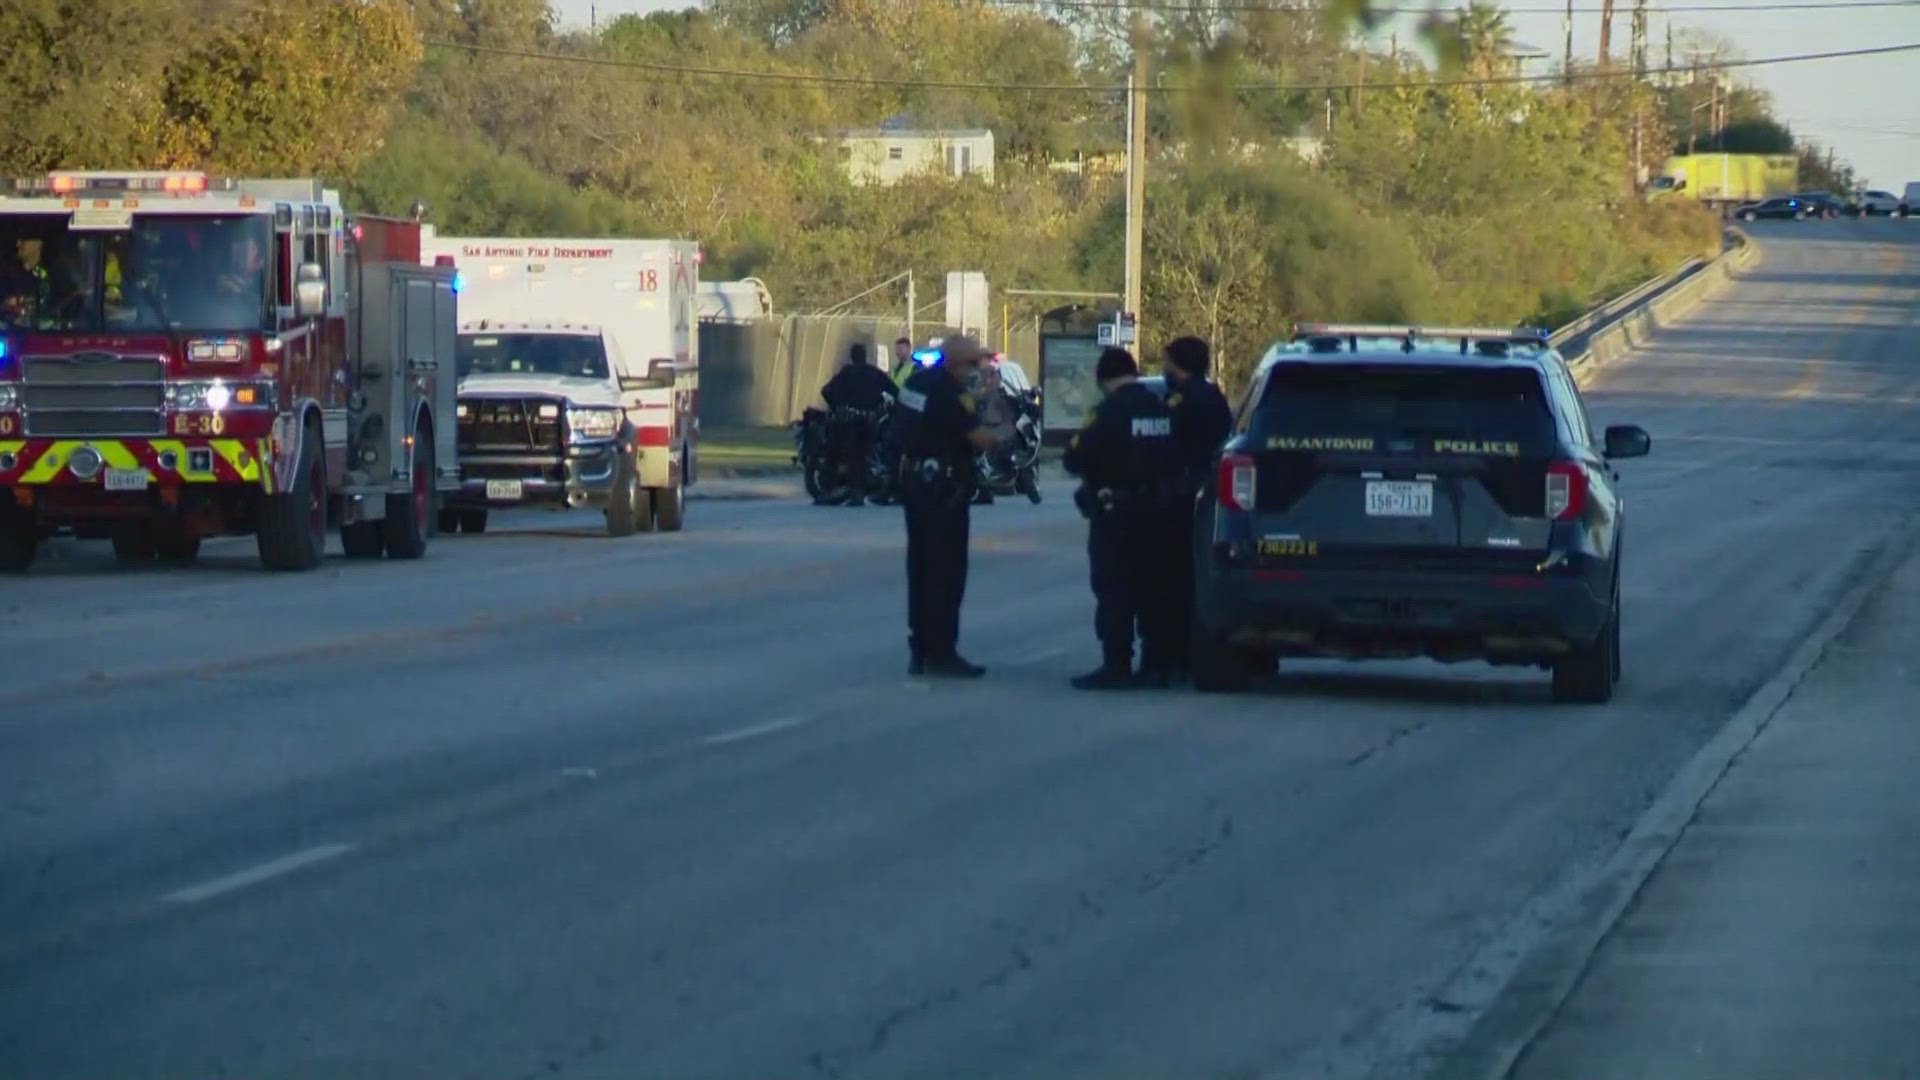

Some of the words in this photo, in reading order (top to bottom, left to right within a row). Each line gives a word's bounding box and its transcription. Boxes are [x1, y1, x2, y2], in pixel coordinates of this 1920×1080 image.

[485, 246, 524, 256] ANTONIO
[527, 247, 550, 257] FIRE
[554, 247, 614, 257] DEPARTMENT
[638, 270, 658, 292] 18
[174, 413, 225, 434] E-30
[1266, 437, 1297, 449] SAN
[1299, 437, 1374, 450] ANTONIO
[1434, 440, 1519, 456] POLICE
